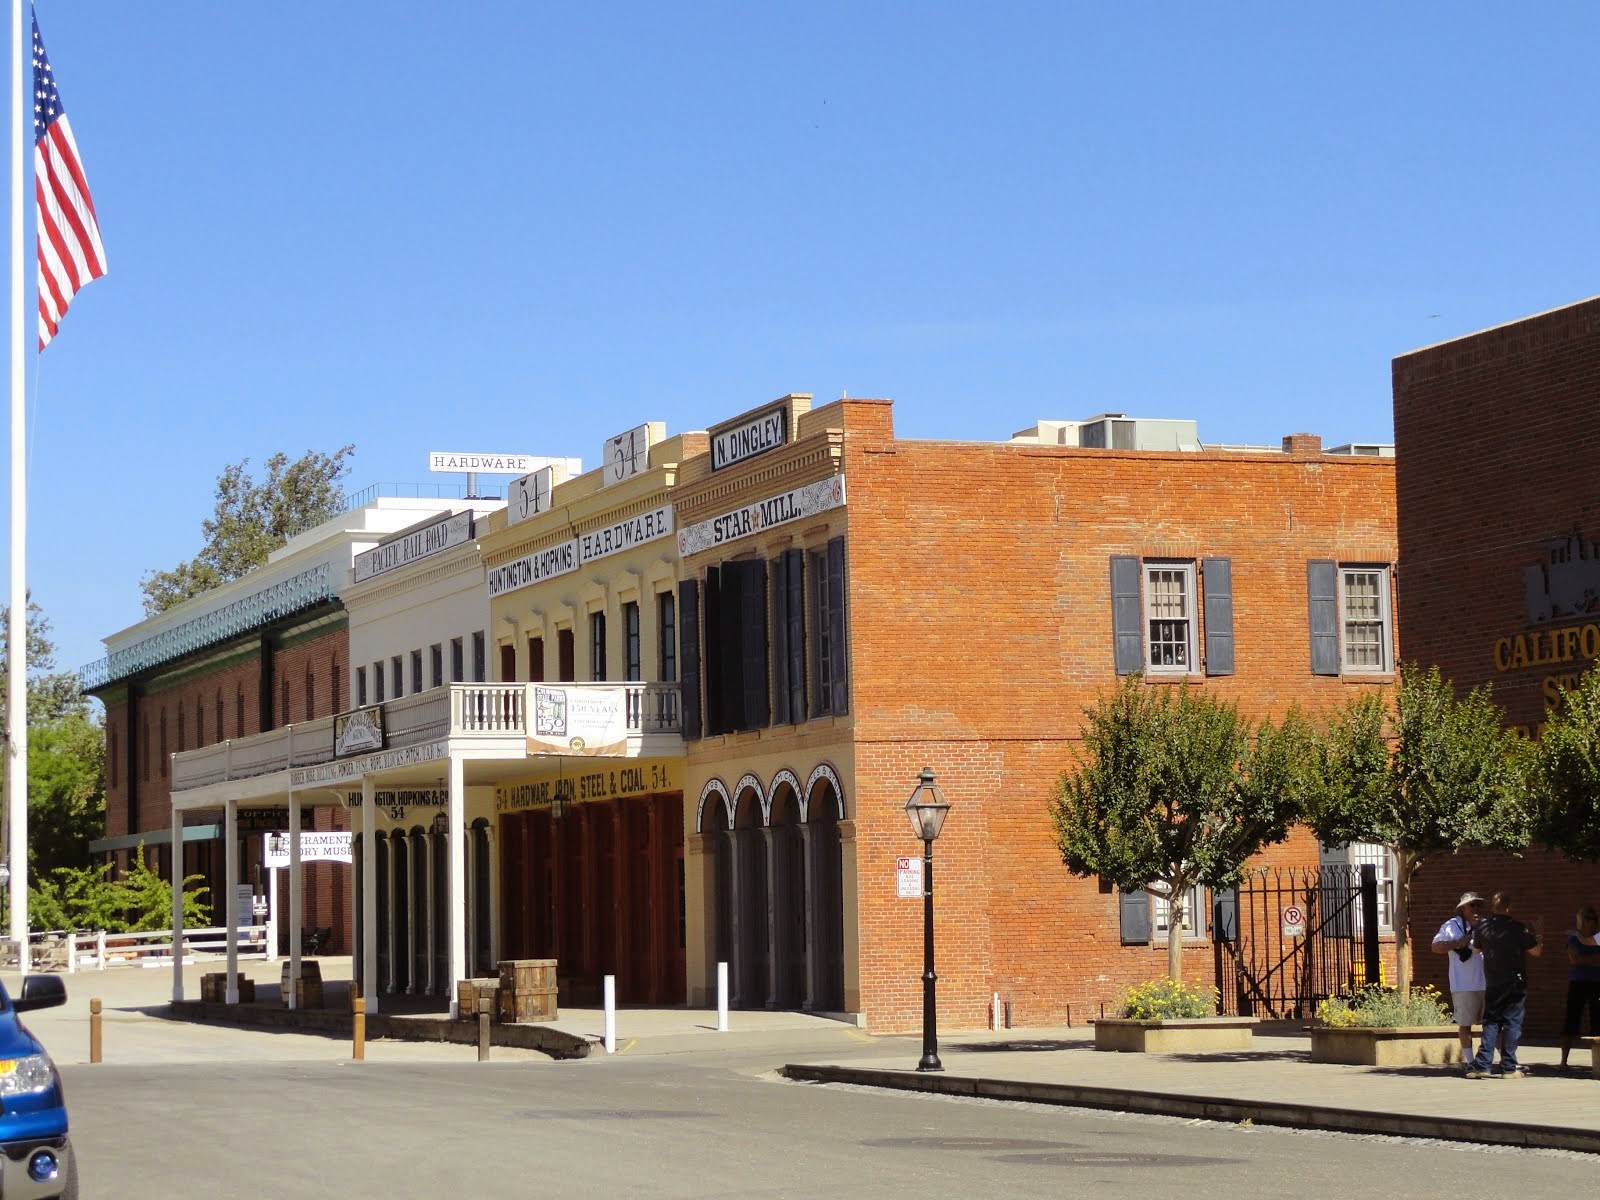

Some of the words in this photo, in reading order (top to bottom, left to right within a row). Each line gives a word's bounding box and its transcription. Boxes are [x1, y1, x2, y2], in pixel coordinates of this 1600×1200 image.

[614, 431, 638, 480] 54
[717, 439, 728, 465] N.
[730, 415, 781, 460] DINGLEY.
[519, 474, 540, 519] 54
[583, 510, 667, 560] HARDWARE.
[713, 508, 752, 543] STAR
[760, 493, 802, 529] MILL.
[372, 543, 401, 573] PACIFIC
[403, 533, 424, 561] RAIL
[426, 523, 448, 553] ROAD
[489, 557, 532, 596] HUNTINGTON
[534, 555, 540, 580] &
[538, 718, 565, 732] 150
[348, 791, 398, 807] HUNNGTON,
[398, 790, 431, 806] HOPKINS
[432, 790, 440, 805] &
[580, 773, 607, 799] STEEL
[610, 771, 617, 795] &
[620, 767, 648, 793] COAL.
[651, 763, 672, 790] 54.
[391, 806, 405, 819] 54
[282, 835, 352, 845] SCRAMENT
[899, 860, 908, 869] NO
